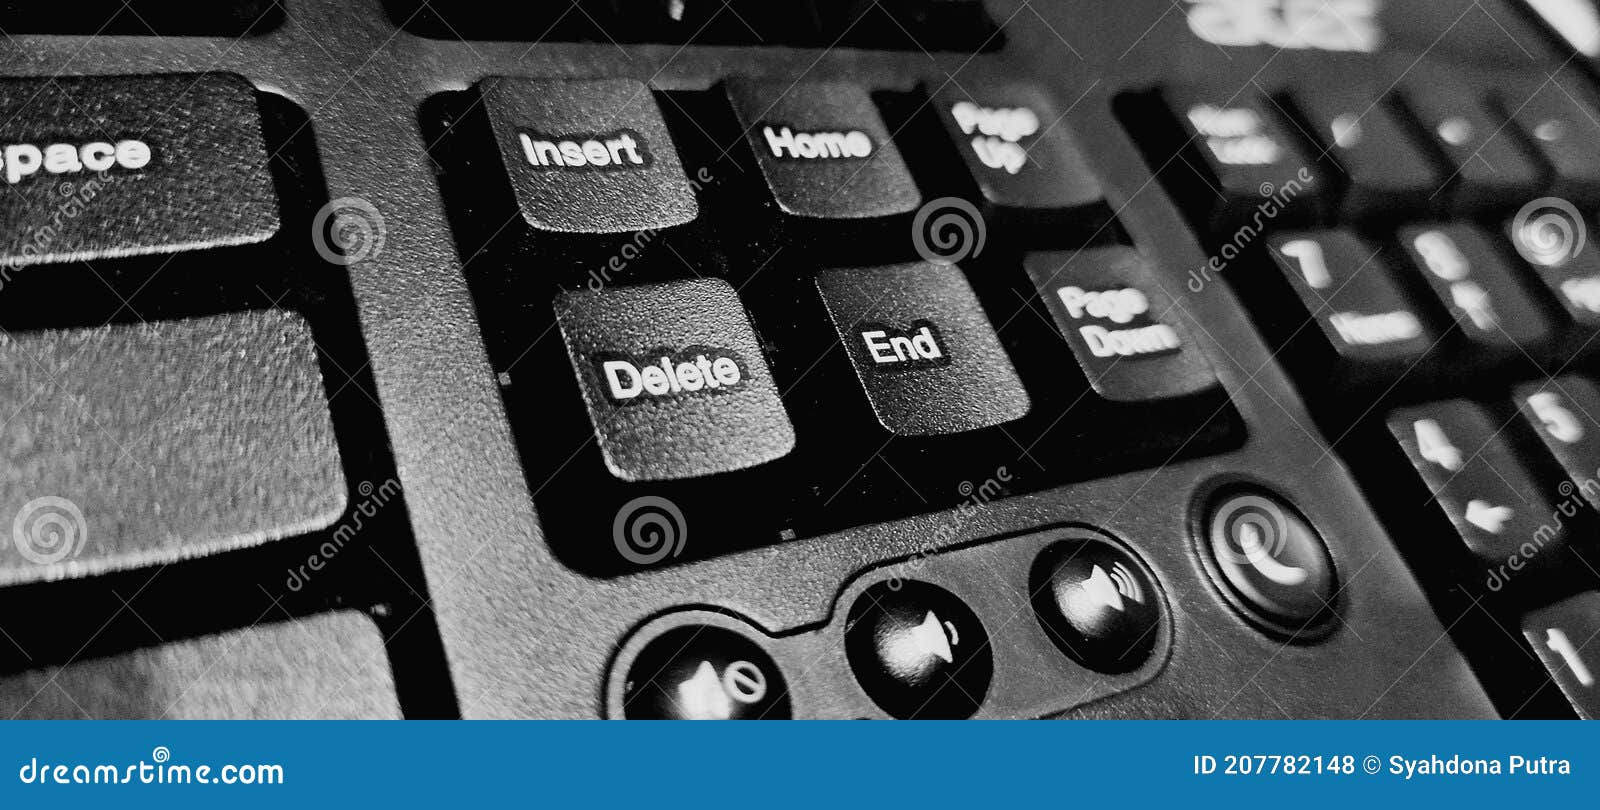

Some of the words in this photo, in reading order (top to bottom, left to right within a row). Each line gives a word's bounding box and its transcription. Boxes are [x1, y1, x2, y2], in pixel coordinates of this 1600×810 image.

[0, 140, 151, 183] pace
[519, 132, 643, 167] Insert
[764, 126, 872, 159] Home
[1281, 241, 1328, 288] 7
[1057, 287, 1147, 323] Page
[861, 328, 942, 364] End
[1080, 325, 1180, 357] Down
[603, 355, 741, 399] Delete
[1528, 393, 1579, 442] 5
[1414, 420, 1458, 469] 4
[1547, 629, 1592, 685] 1
